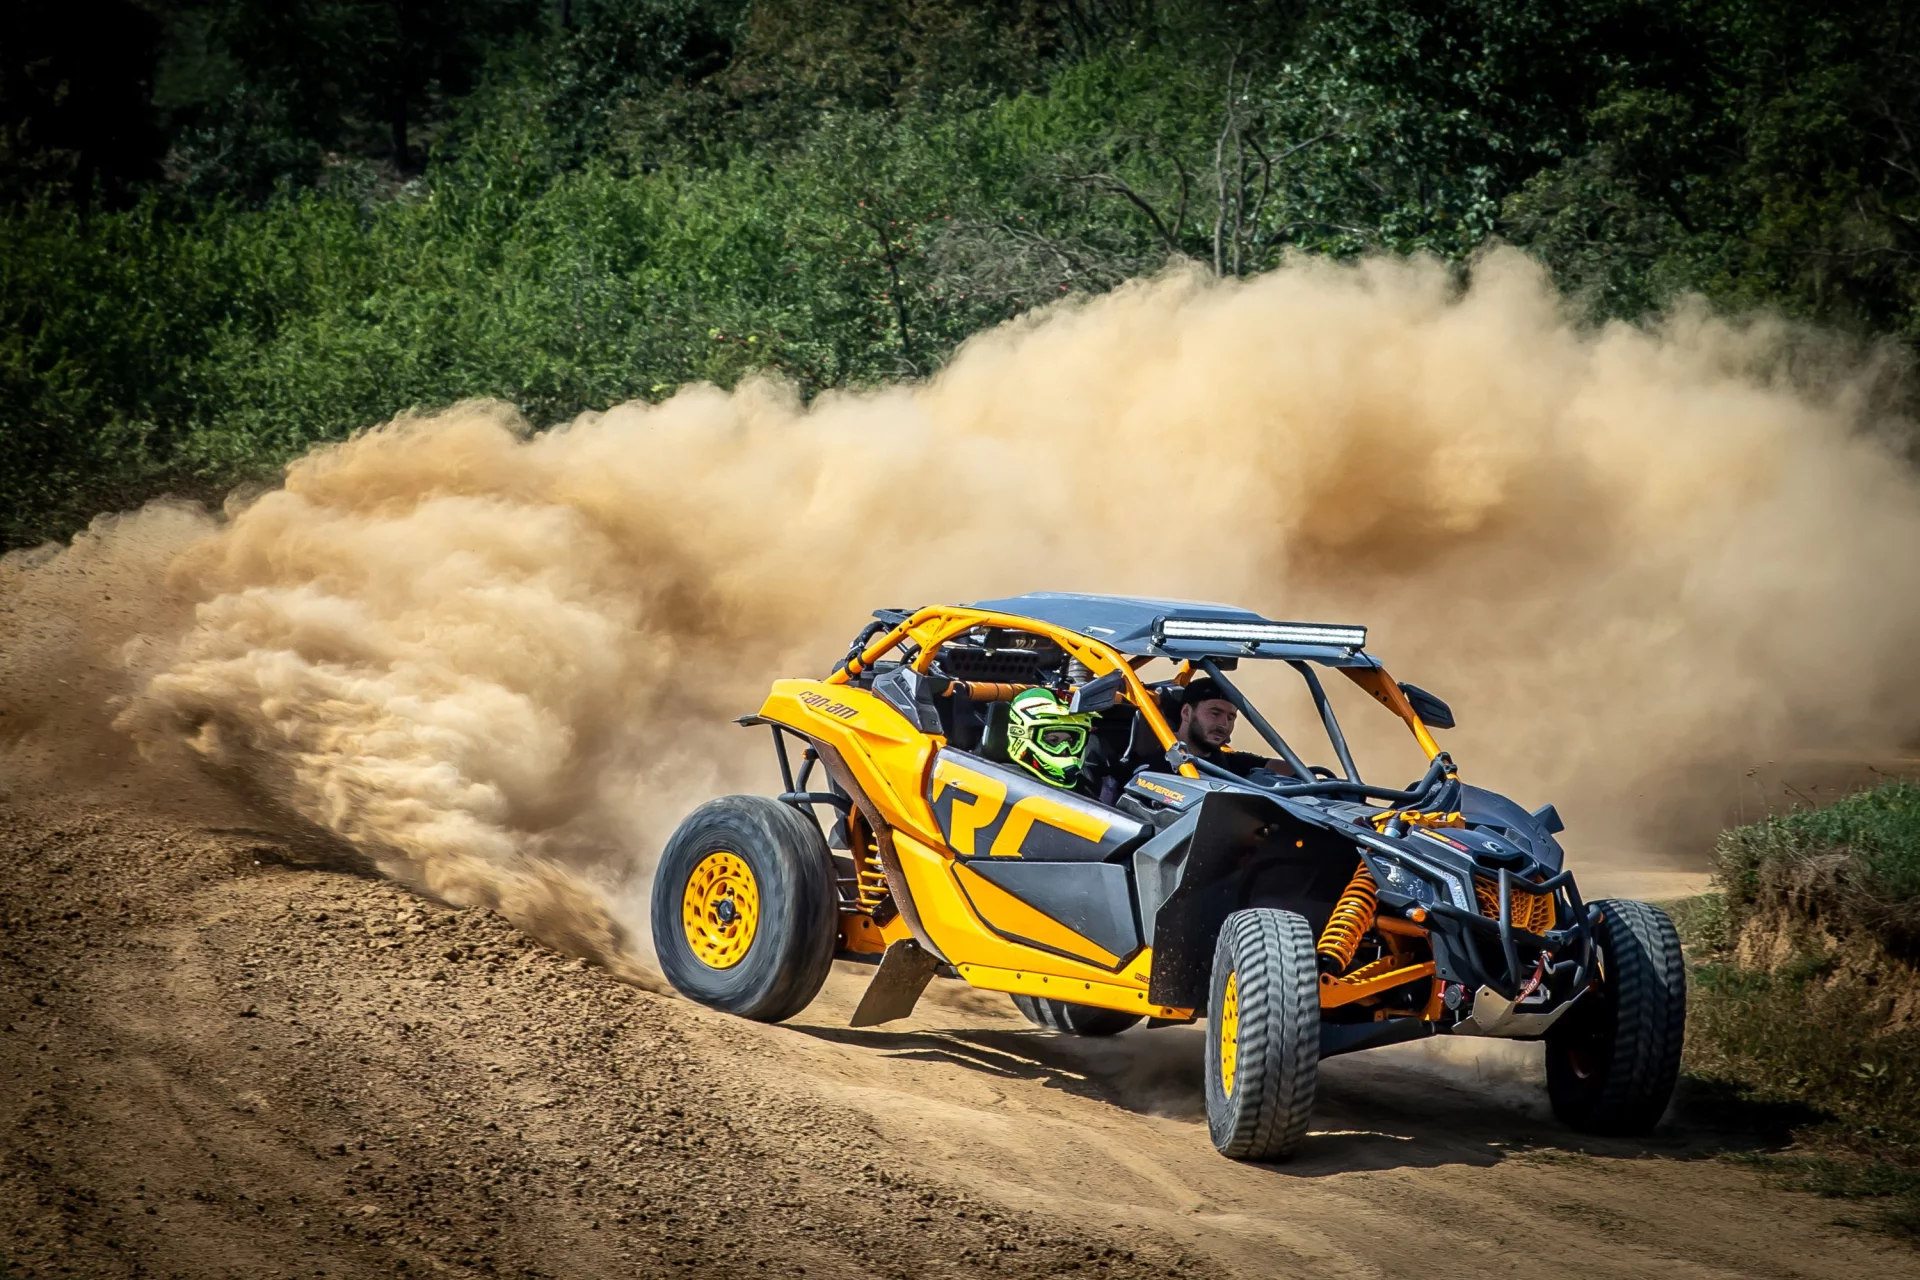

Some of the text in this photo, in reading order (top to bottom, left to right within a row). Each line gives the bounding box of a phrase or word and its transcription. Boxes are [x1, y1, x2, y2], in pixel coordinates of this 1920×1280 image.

[799, 691, 859, 719] can-am
[1136, 778, 1185, 802] MAVERICK
[1419, 828, 1451, 843] TURBO
